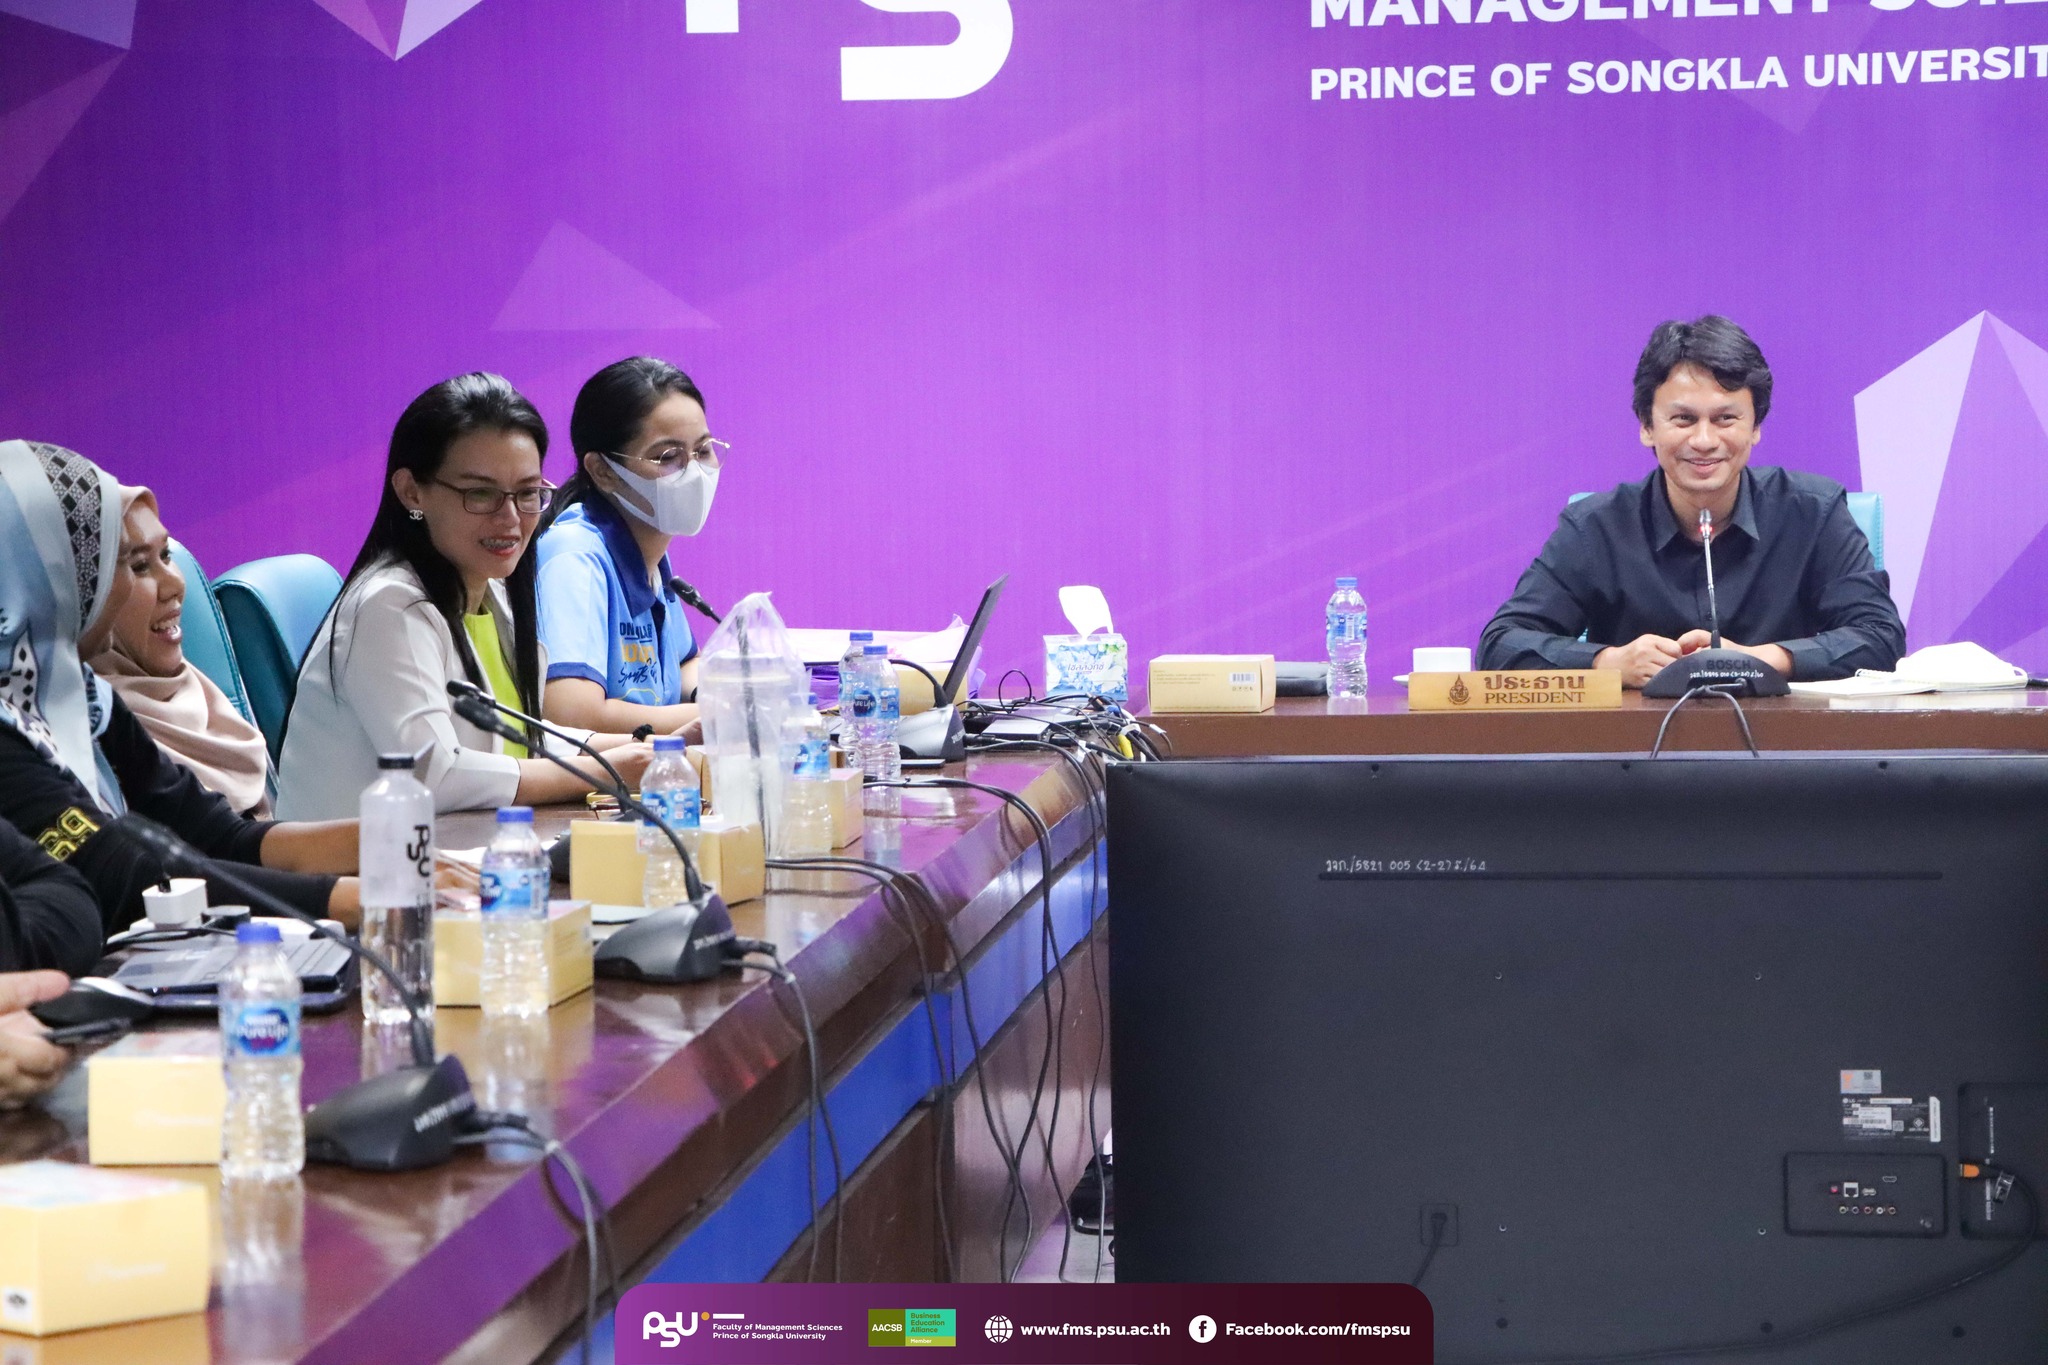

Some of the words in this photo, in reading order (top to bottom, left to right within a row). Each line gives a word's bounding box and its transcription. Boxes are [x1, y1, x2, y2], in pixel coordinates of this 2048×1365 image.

[1311, 65, 1475, 100] PRINCE
[1490, 63, 1552, 96] OF
[1567, 56, 1789, 94] SONGKLA
[1804, 45, 2048, 88] UNIVERSIT
[1706, 659, 1751, 670] BOSCH
[1484, 674, 1585, 690] ประธาน
[1484, 691, 1586, 704] PRESIDENT
[1389, 860, 1411, 871] 005
